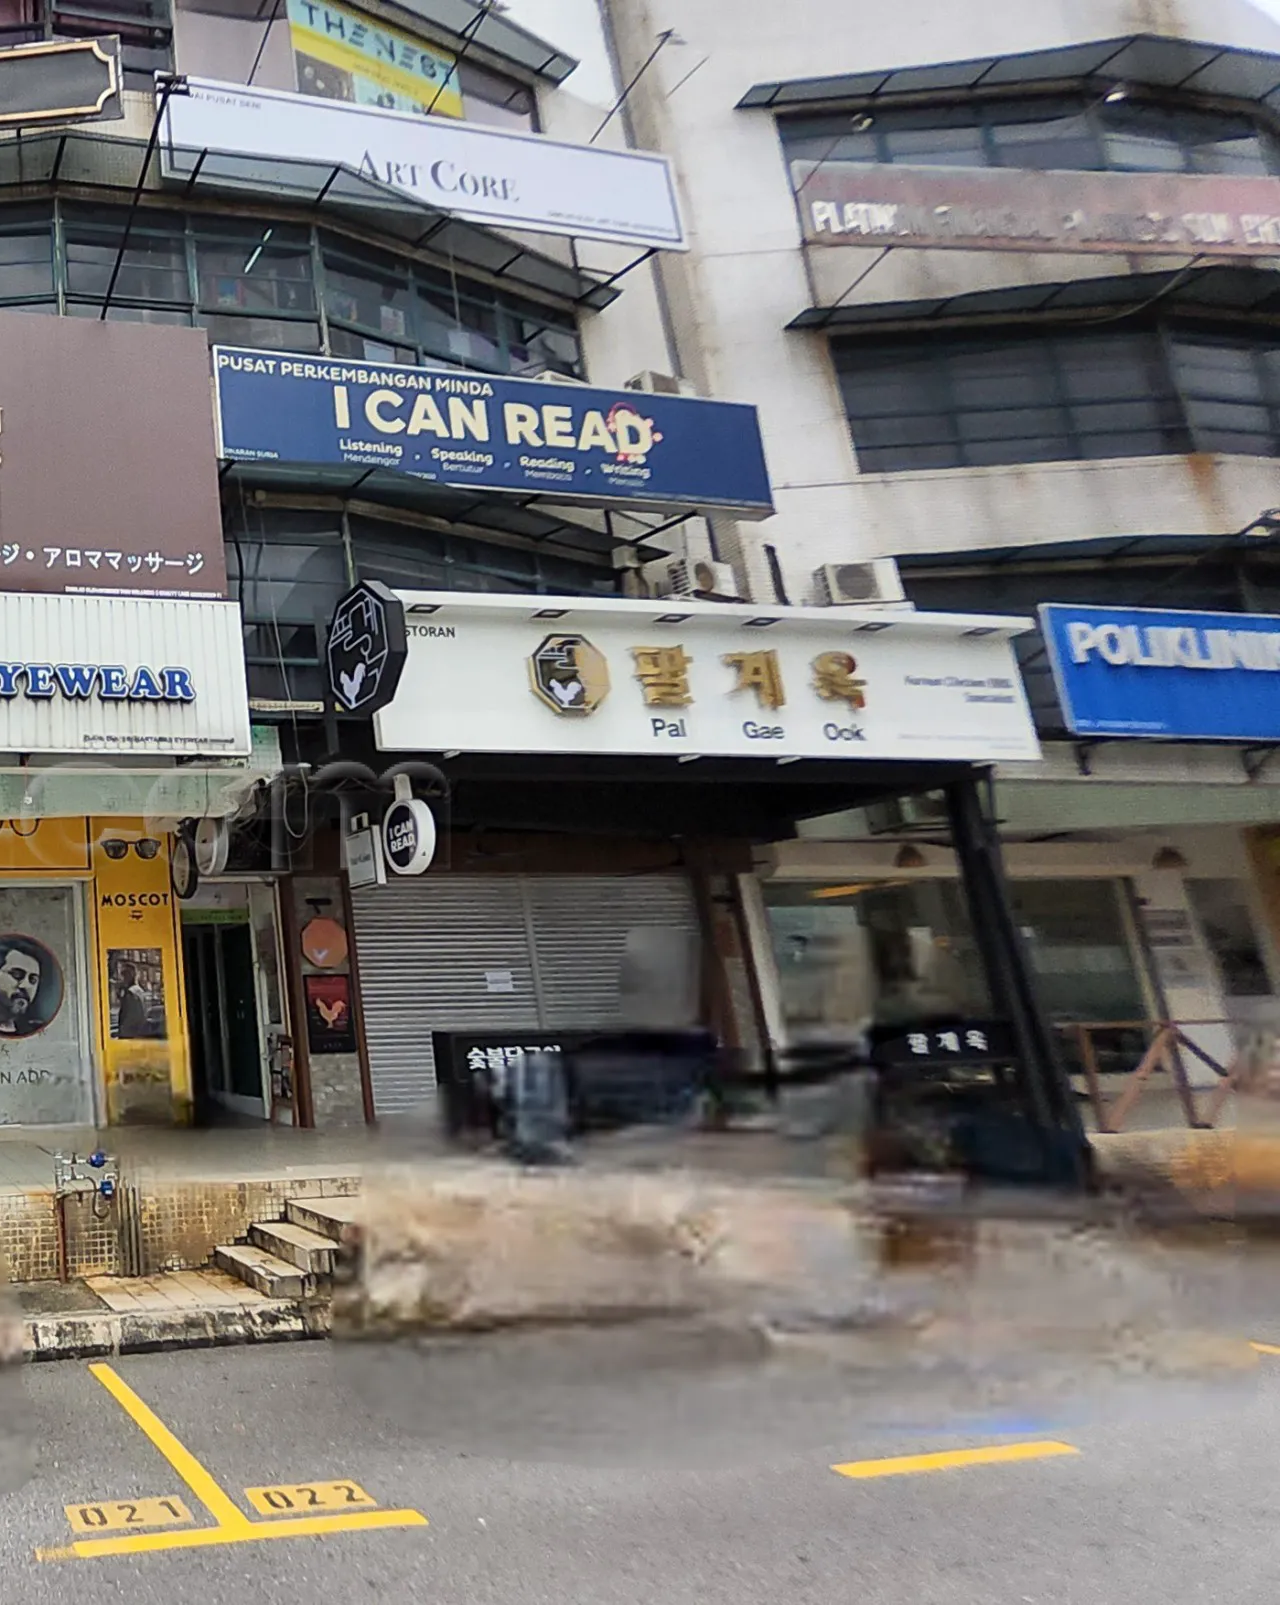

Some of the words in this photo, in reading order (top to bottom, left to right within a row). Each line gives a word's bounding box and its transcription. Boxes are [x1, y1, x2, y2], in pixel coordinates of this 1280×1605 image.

[218, 355, 276, 376] PUSAT
[280, 362, 432, 391] PERKEMBANGAN
[435, 377, 494, 398] MINDA
[333, 385, 351, 429] I
[365, 391, 489, 441] CAN
[504, 403, 655, 455] READ
[339, 438, 403, 457] Listening
[431, 447, 494, 467] Speaking
[520, 456, 575, 473] Reading
[43, 546, 205, 576] アロママッサージ
[650, 717, 687, 739] Pal
[742, 721, 785, 740] Gae
[823, 722, 867, 742] Ook
[388, 827, 394, 840] I
[393, 818, 414, 837] CAN
[390, 833, 417, 853] READ
[101, 893, 169, 907] MOSCOT
[261, 1484, 366, 1510] 022
[79, 1499, 181, 1529] 021
